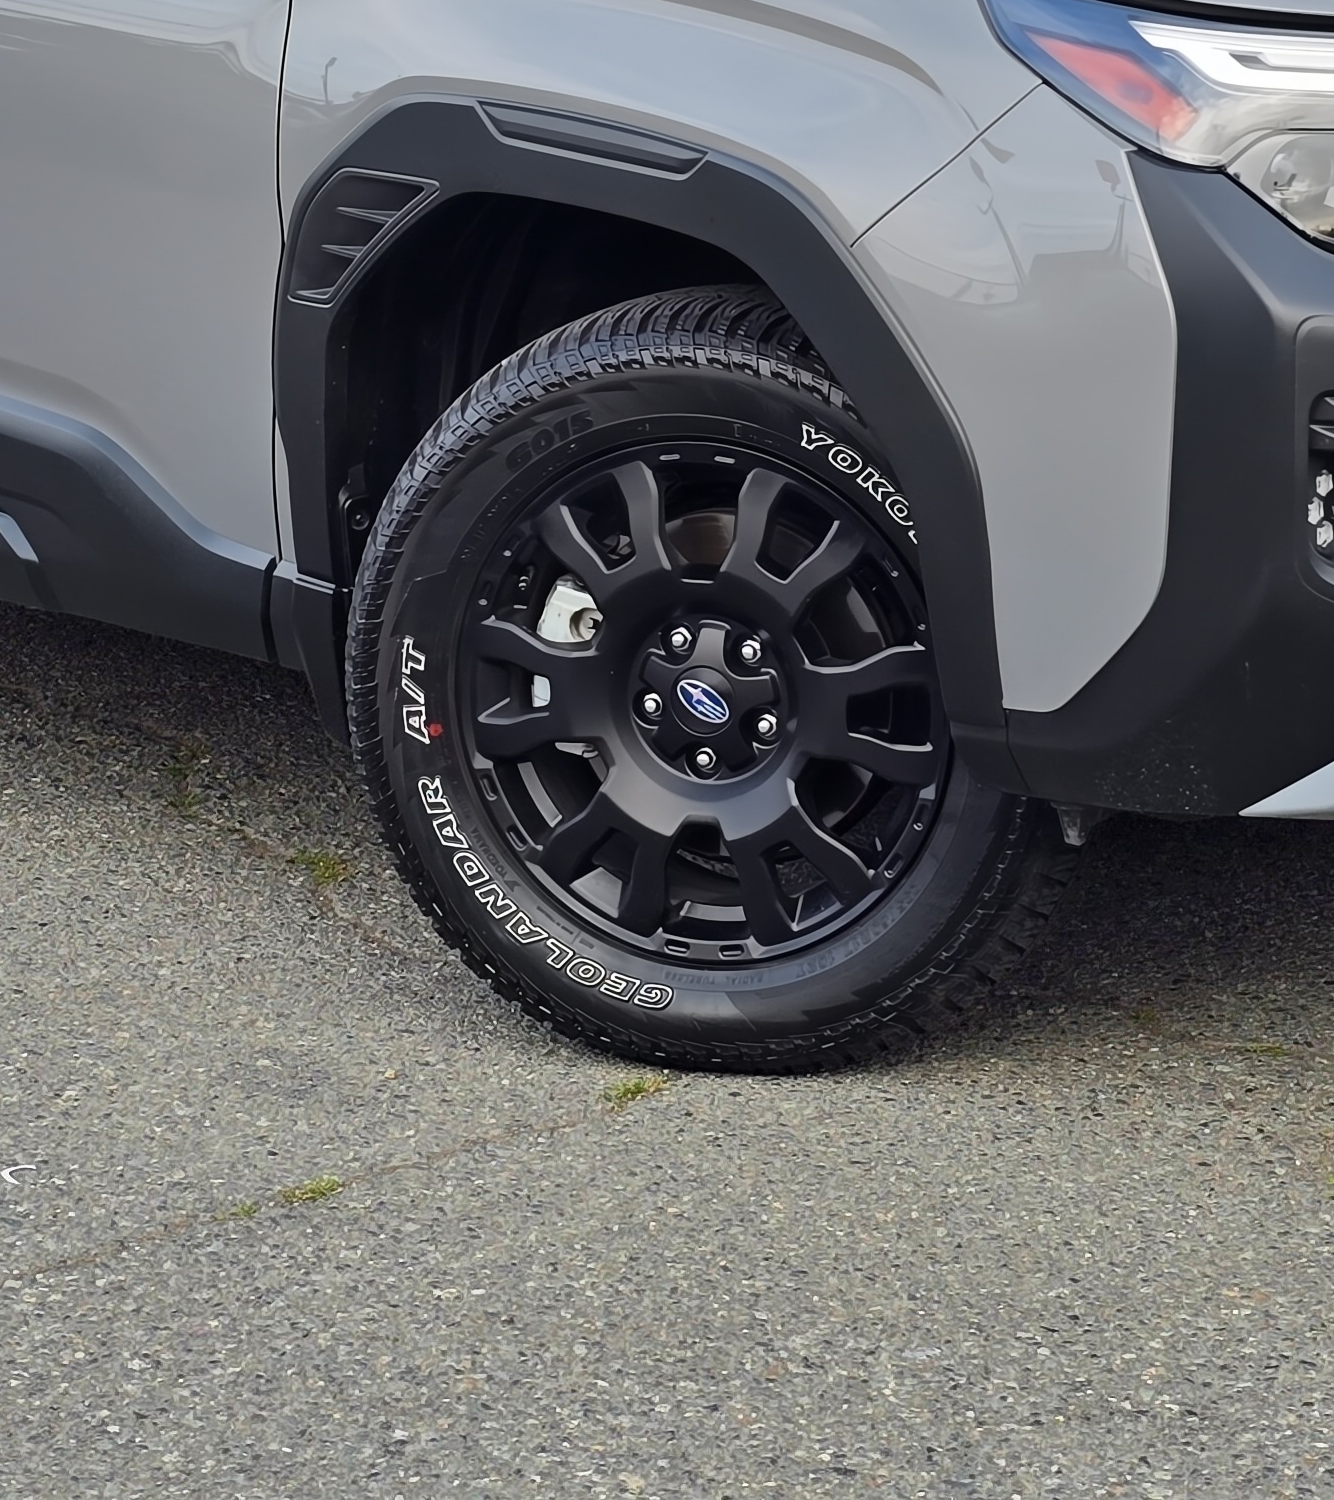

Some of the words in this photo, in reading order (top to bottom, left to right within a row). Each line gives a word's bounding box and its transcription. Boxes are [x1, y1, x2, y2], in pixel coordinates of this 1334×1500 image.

[800, 421, 918, 545] YOKO
[401, 634, 431, 745] A/T
[417, 775, 675, 1008] GEOLANDAR
